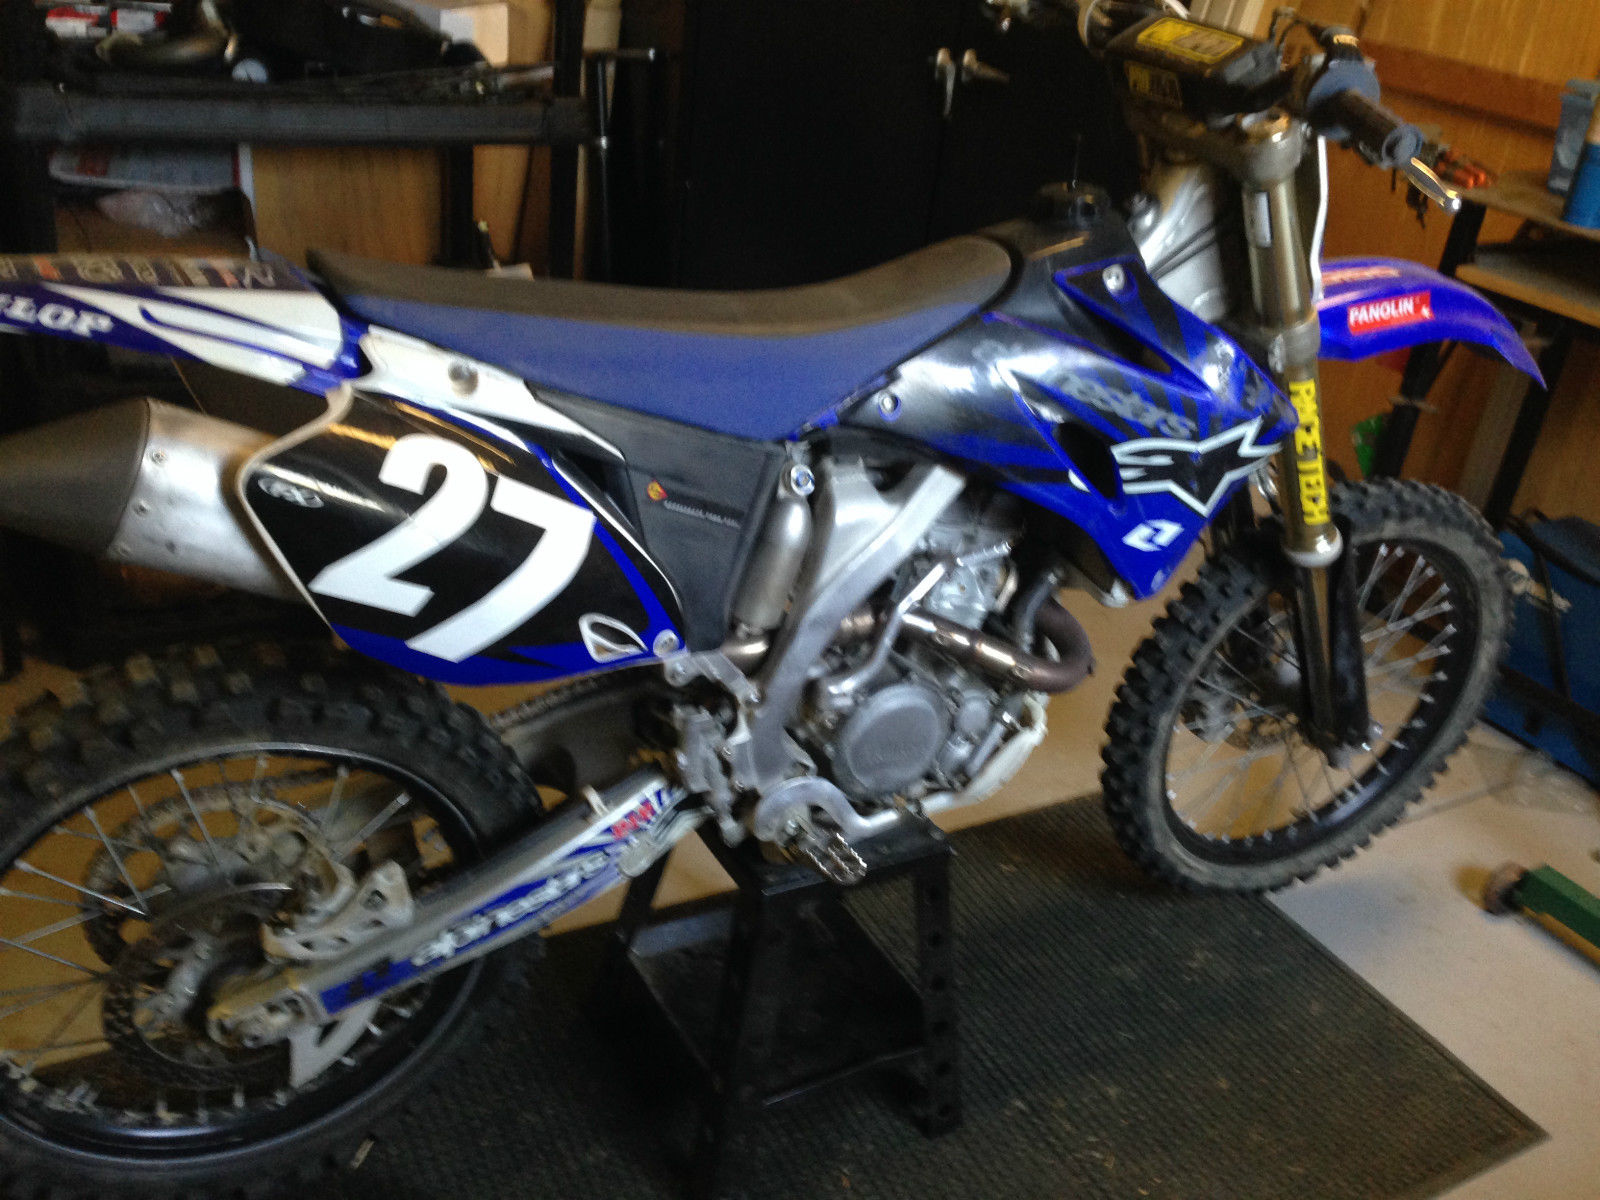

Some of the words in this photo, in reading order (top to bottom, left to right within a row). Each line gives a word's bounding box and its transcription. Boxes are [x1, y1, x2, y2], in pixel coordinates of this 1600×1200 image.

[0, 293, 114, 338] LOP
[1348, 296, 1416, 327] PANOLIN
[308, 432, 598, 664] 27
